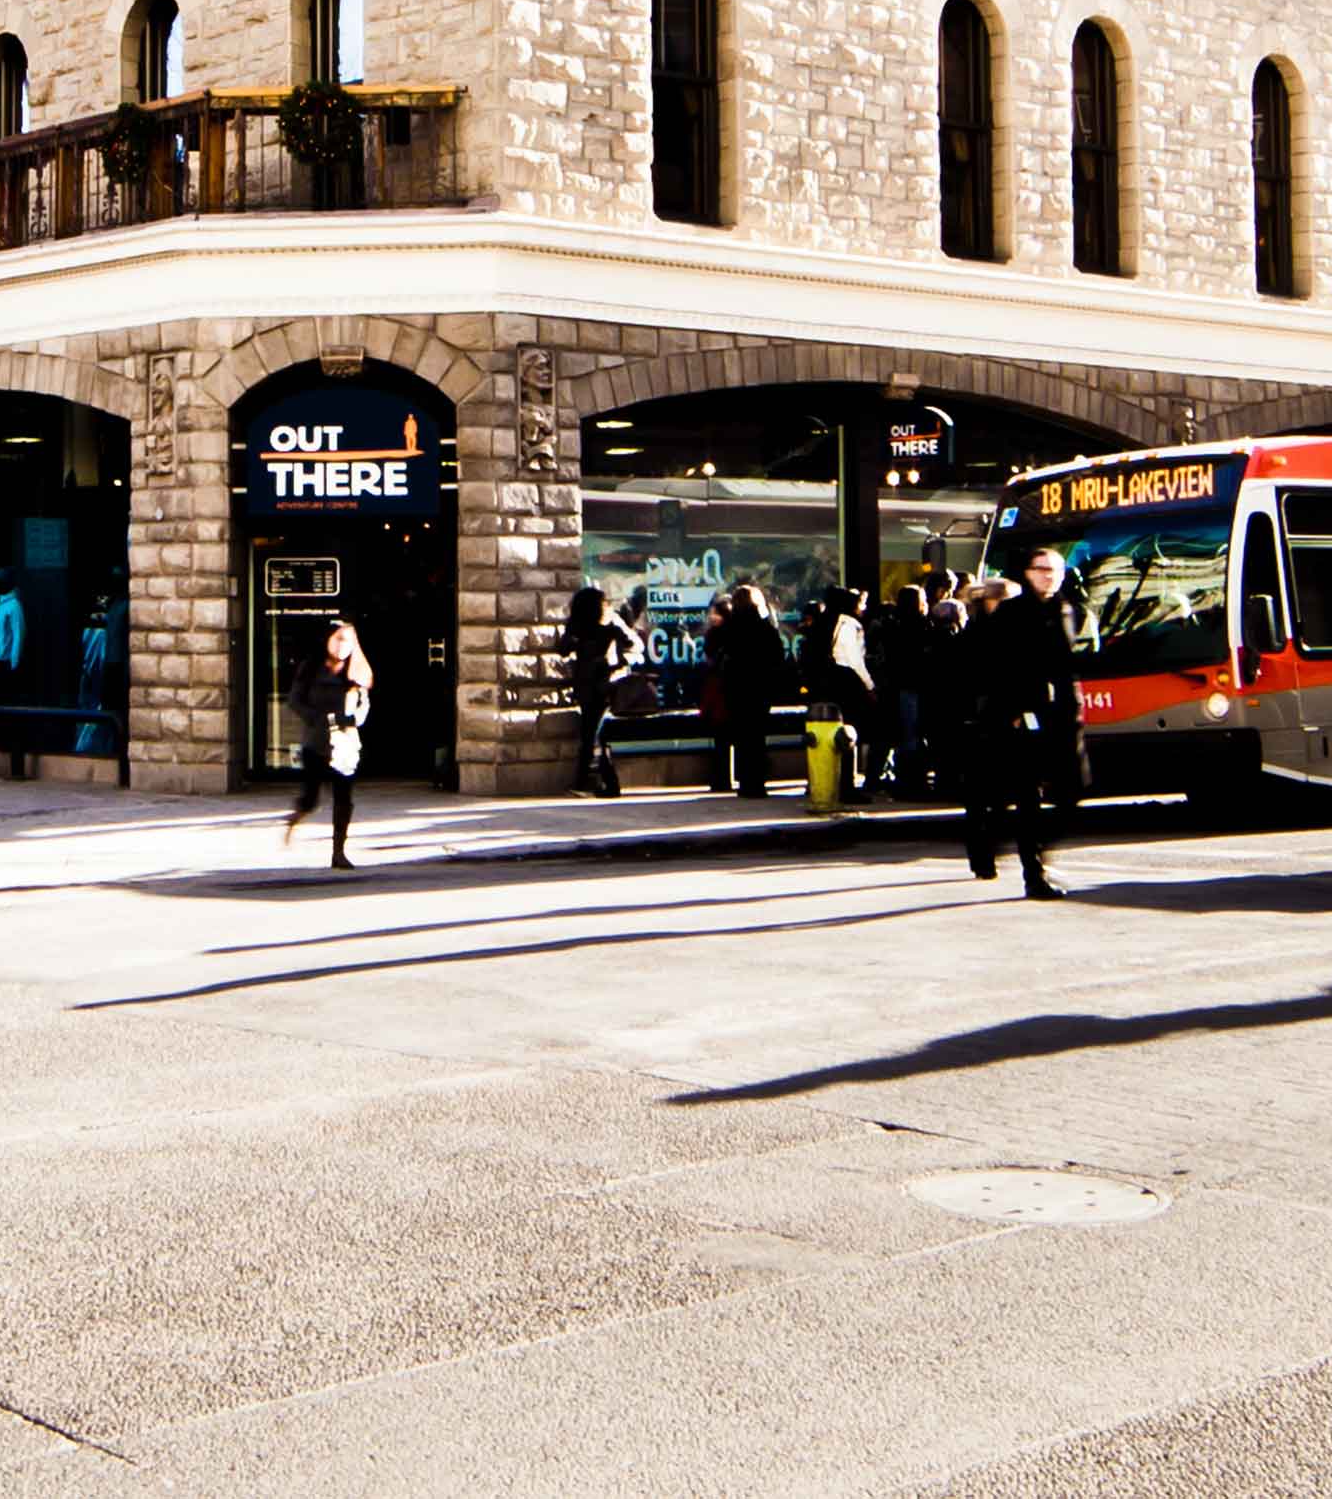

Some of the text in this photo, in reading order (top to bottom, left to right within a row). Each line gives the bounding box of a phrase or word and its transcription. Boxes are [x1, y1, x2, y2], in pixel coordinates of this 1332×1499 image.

[269, 425, 344, 452] OUT
[890, 424, 916, 438] OUT
[889, 439, 939, 457] THERE
[267, 462, 409, 497] THERE
[1040, 463, 1214, 515] 18 MRU-LAKEVIEW
[1077, 691, 1113, 709] 141
